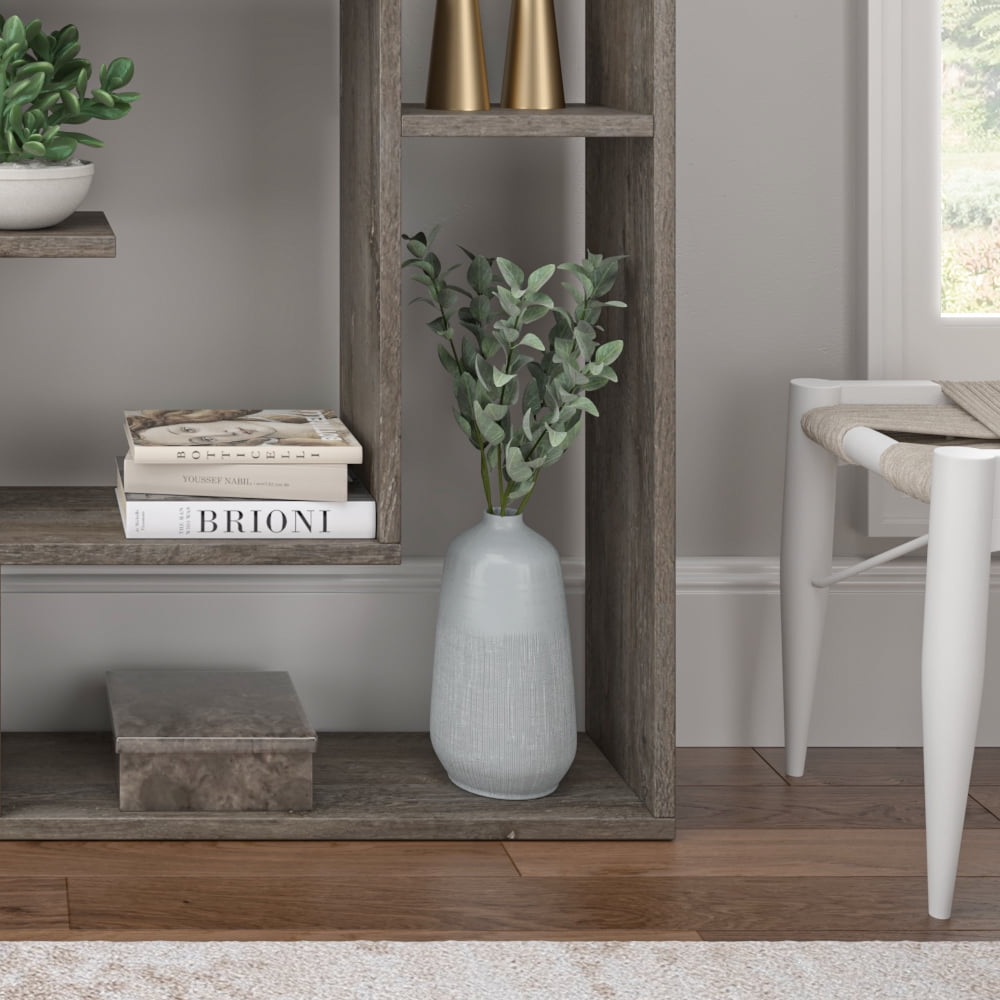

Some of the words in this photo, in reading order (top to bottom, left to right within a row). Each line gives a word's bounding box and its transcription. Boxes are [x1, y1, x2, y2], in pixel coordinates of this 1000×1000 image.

[177, 450, 320, 460] BOTTICELLI
[182, 475, 222, 485] YOUSSEF
[197, 509, 332, 534] BRIONI
